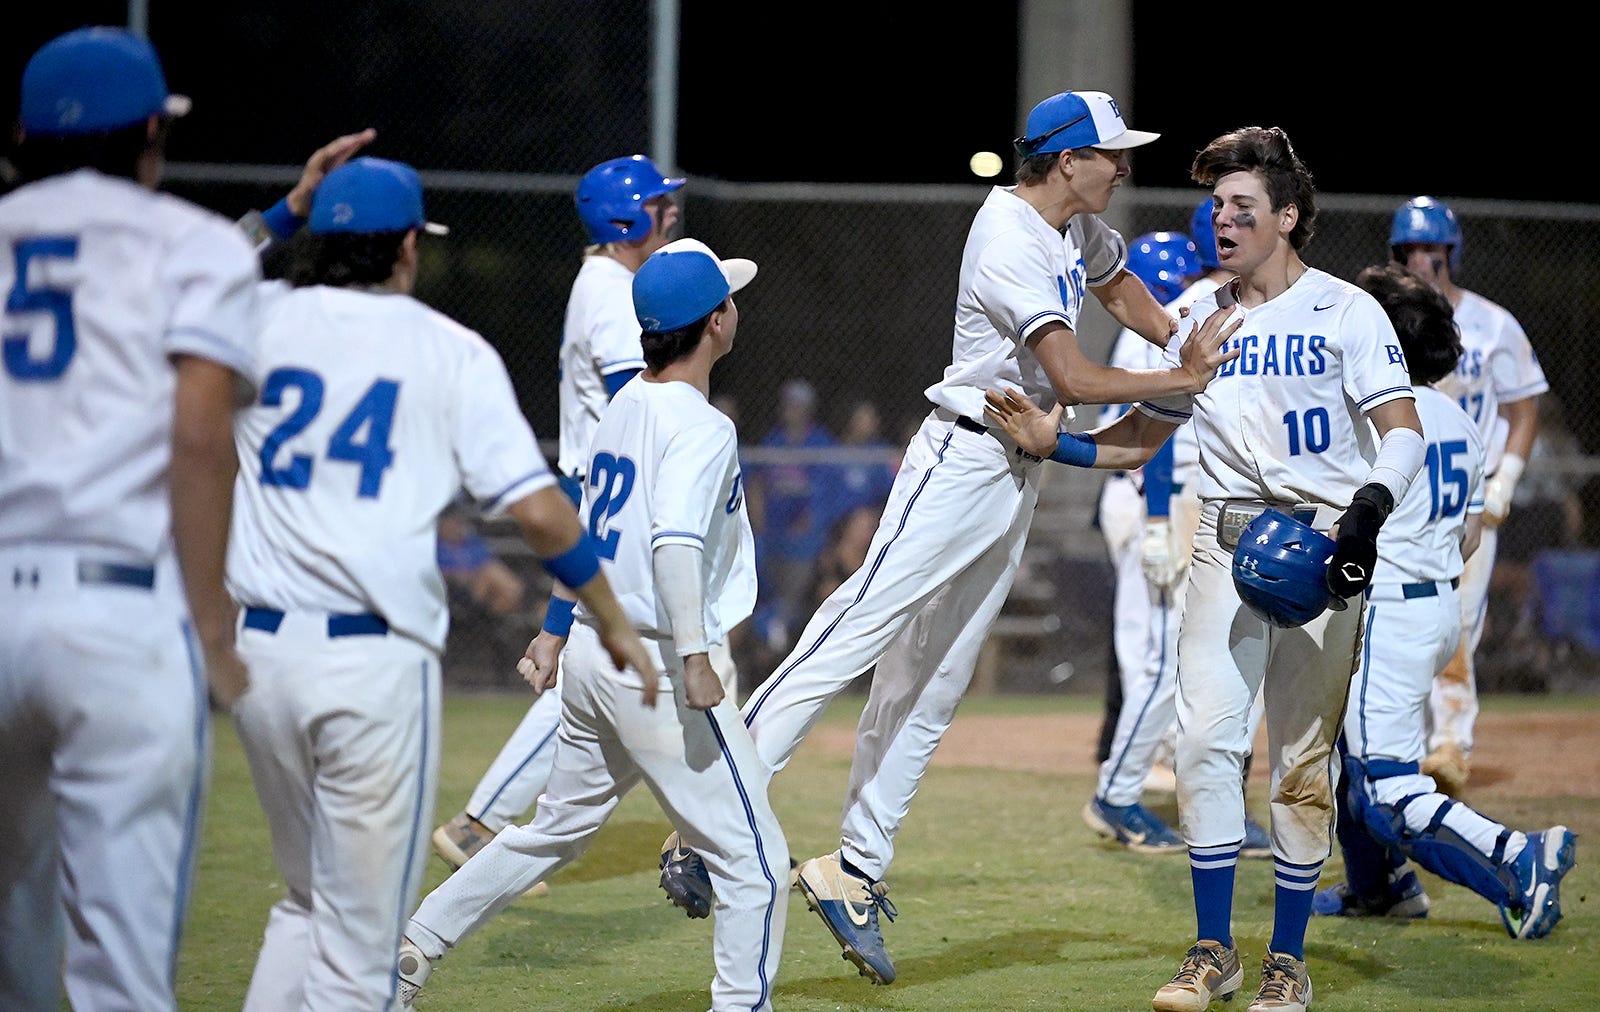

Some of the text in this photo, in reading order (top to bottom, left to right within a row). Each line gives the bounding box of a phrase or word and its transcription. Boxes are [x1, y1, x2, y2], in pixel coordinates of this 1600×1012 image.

[2, 234, 81, 381] 5
[1213, 334, 1327, 377] UGARS
[257, 367, 402, 500] 24
[1283, 407, 1331, 457] 10
[1424, 439, 1468, 521] 15
[589, 451, 636, 561] 22
